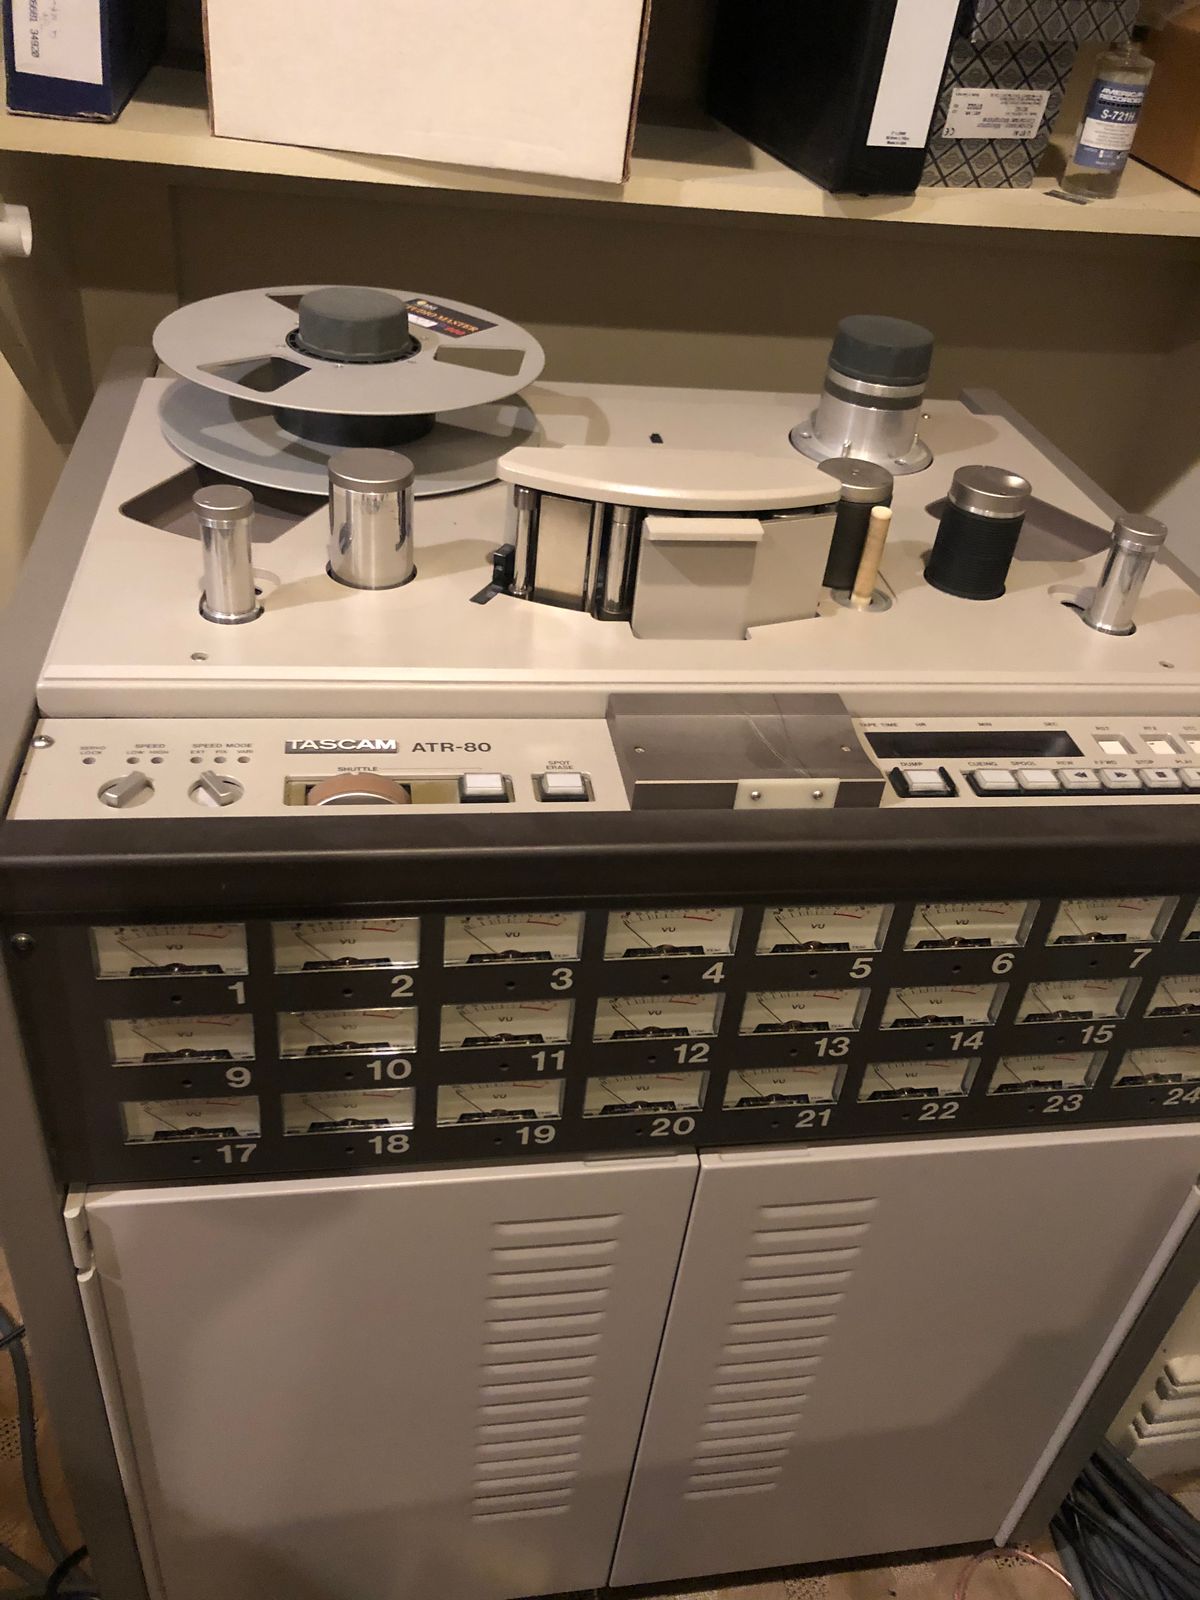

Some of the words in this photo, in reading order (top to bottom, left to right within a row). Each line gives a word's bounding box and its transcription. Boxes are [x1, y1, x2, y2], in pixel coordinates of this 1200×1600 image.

[1101, 109, 1137, 122] S-721H
[286, 739, 397, 750] TASCAM
[411, 742, 492, 752] ATR-80
[849, 957, 873, 979] 5
[991, 952, 1016, 975] 6
[1129, 948, 1152, 969] 7
[550, 968, 573, 990] 3
[702, 962, 725, 984] 4
[228, 981, 245, 1004] 1
[391, 975, 414, 998] 2
[950, 1030, 985, 1051] 14
[1081, 1024, 1116, 1045] 15
[673, 1042, 710, 1064] 12
[814, 1036, 850, 1057] 13
[366, 1058, 412, 1081] 10
[531, 1050, 566, 1071] 11
[225, 1066, 251, 1088] 9
[1042, 1093, 1084, 1113] 23
[1162, 1086, 1200, 1106] 24
[795, 1108, 832, 1128] 21
[918, 1101, 960, 1121] 22
[515, 1124, 556, 1145] 19
[649, 1116, 696, 1137] 20
[216, 1143, 257, 1163] 17
[368, 1133, 410, 1154] 18
